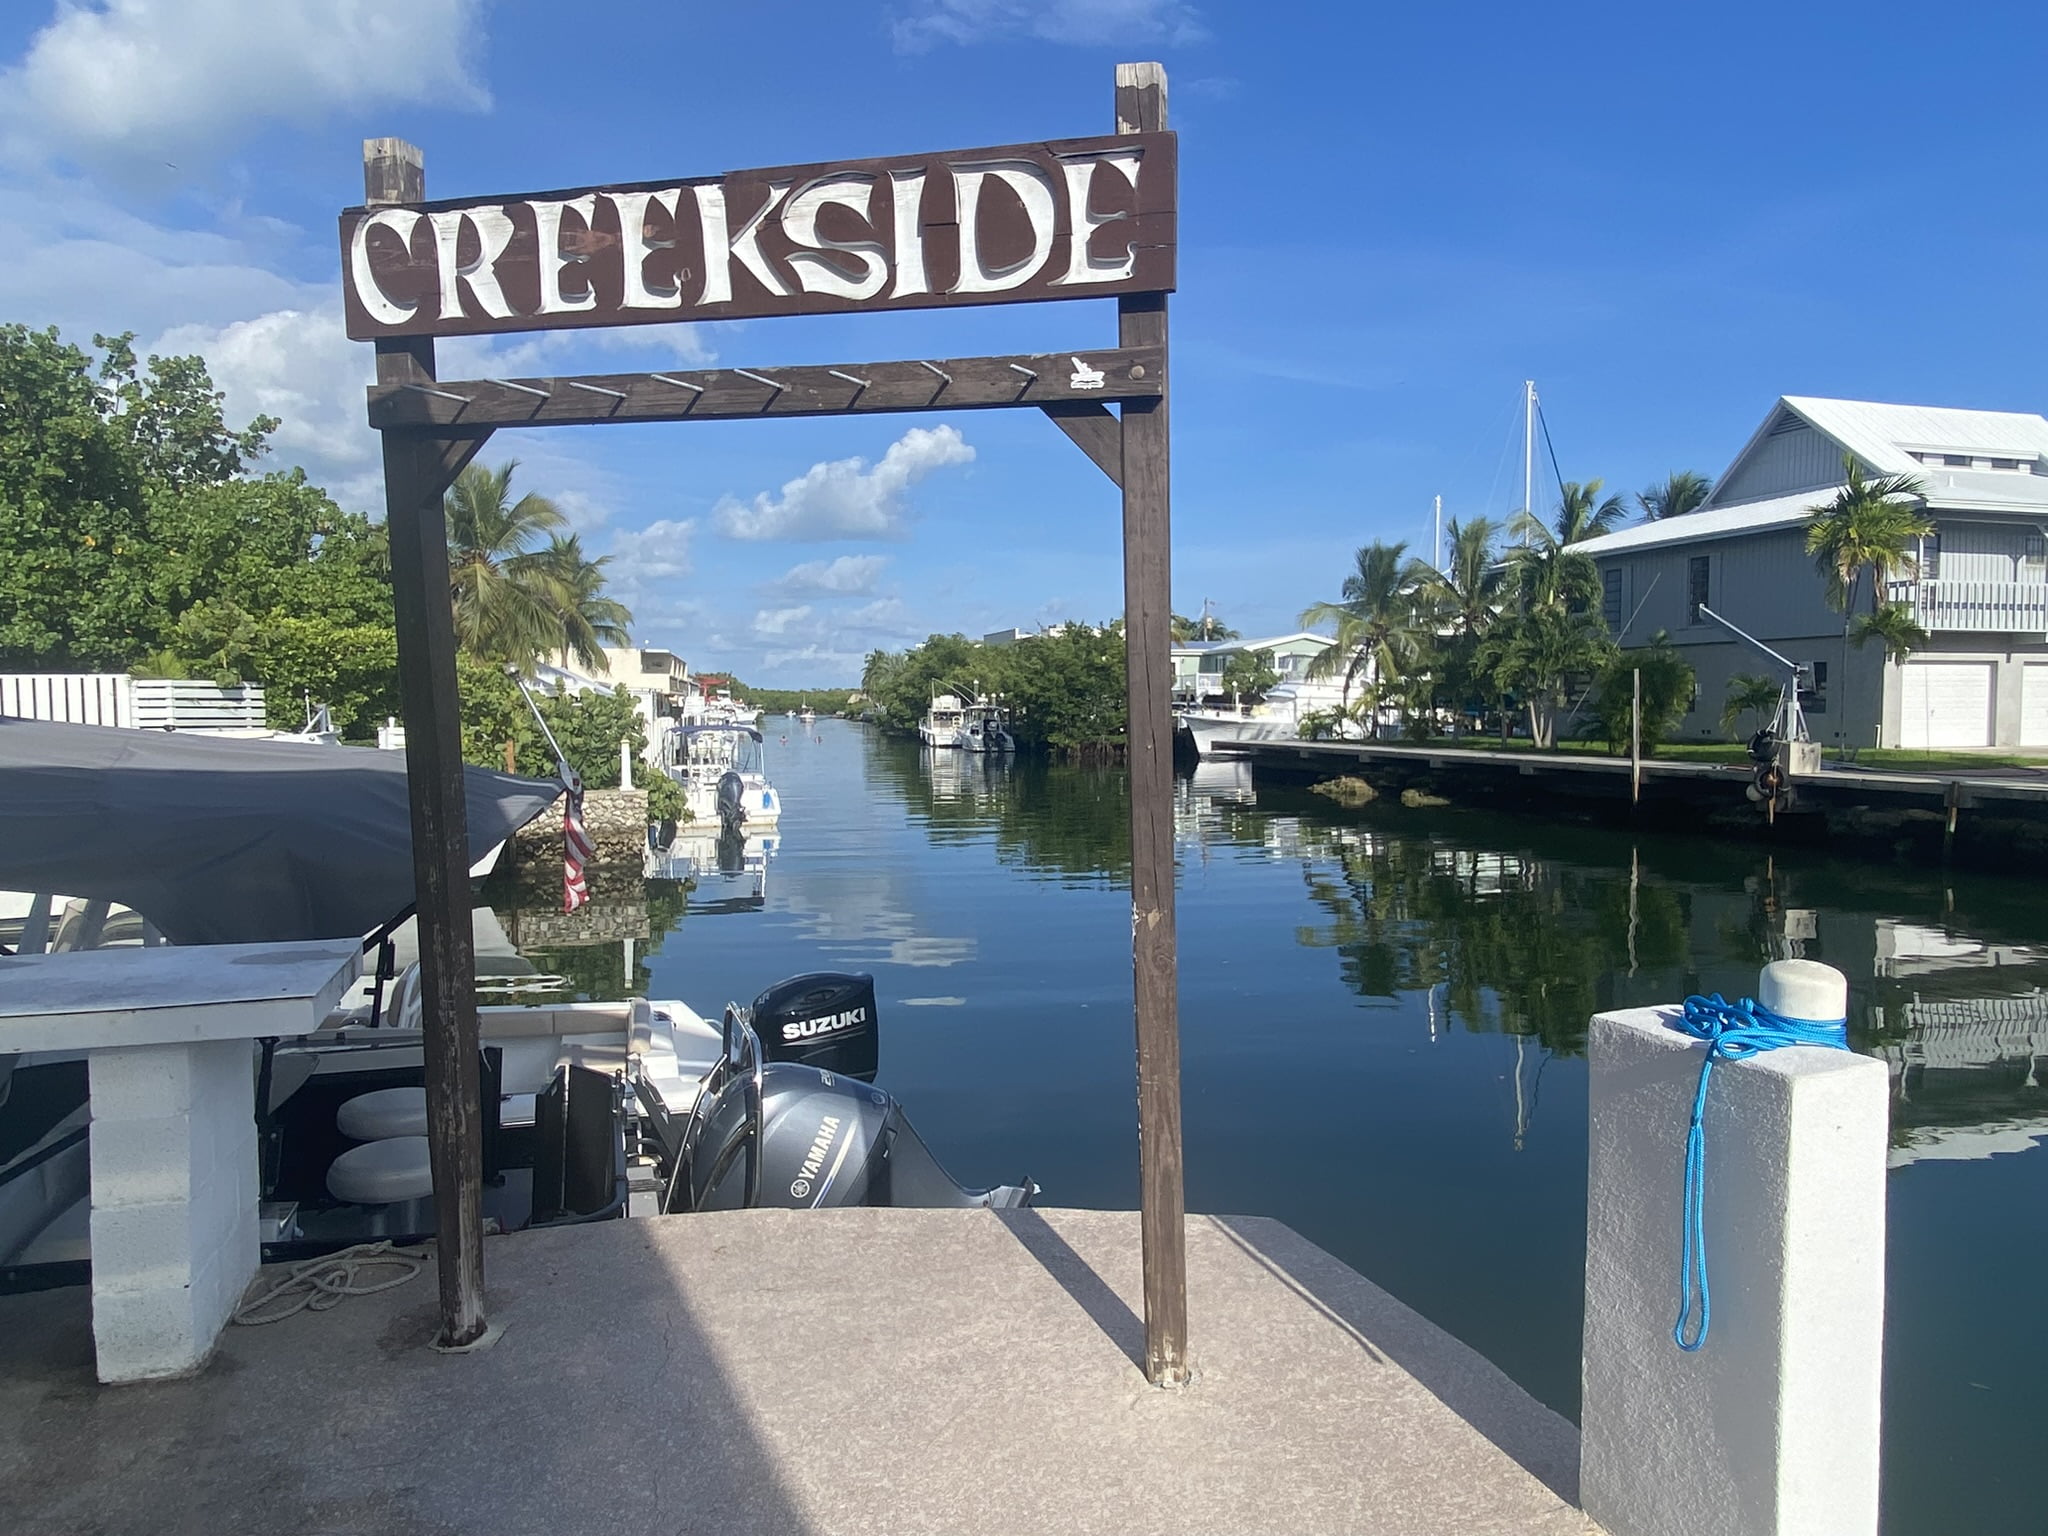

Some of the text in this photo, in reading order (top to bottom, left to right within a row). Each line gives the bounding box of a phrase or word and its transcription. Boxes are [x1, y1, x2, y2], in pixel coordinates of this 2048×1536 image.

[351, 150, 1142, 325] CREEKSIDE
[782, 1007, 866, 1039] SUZUKI
[798, 1116, 840, 1179] YAMAHA
